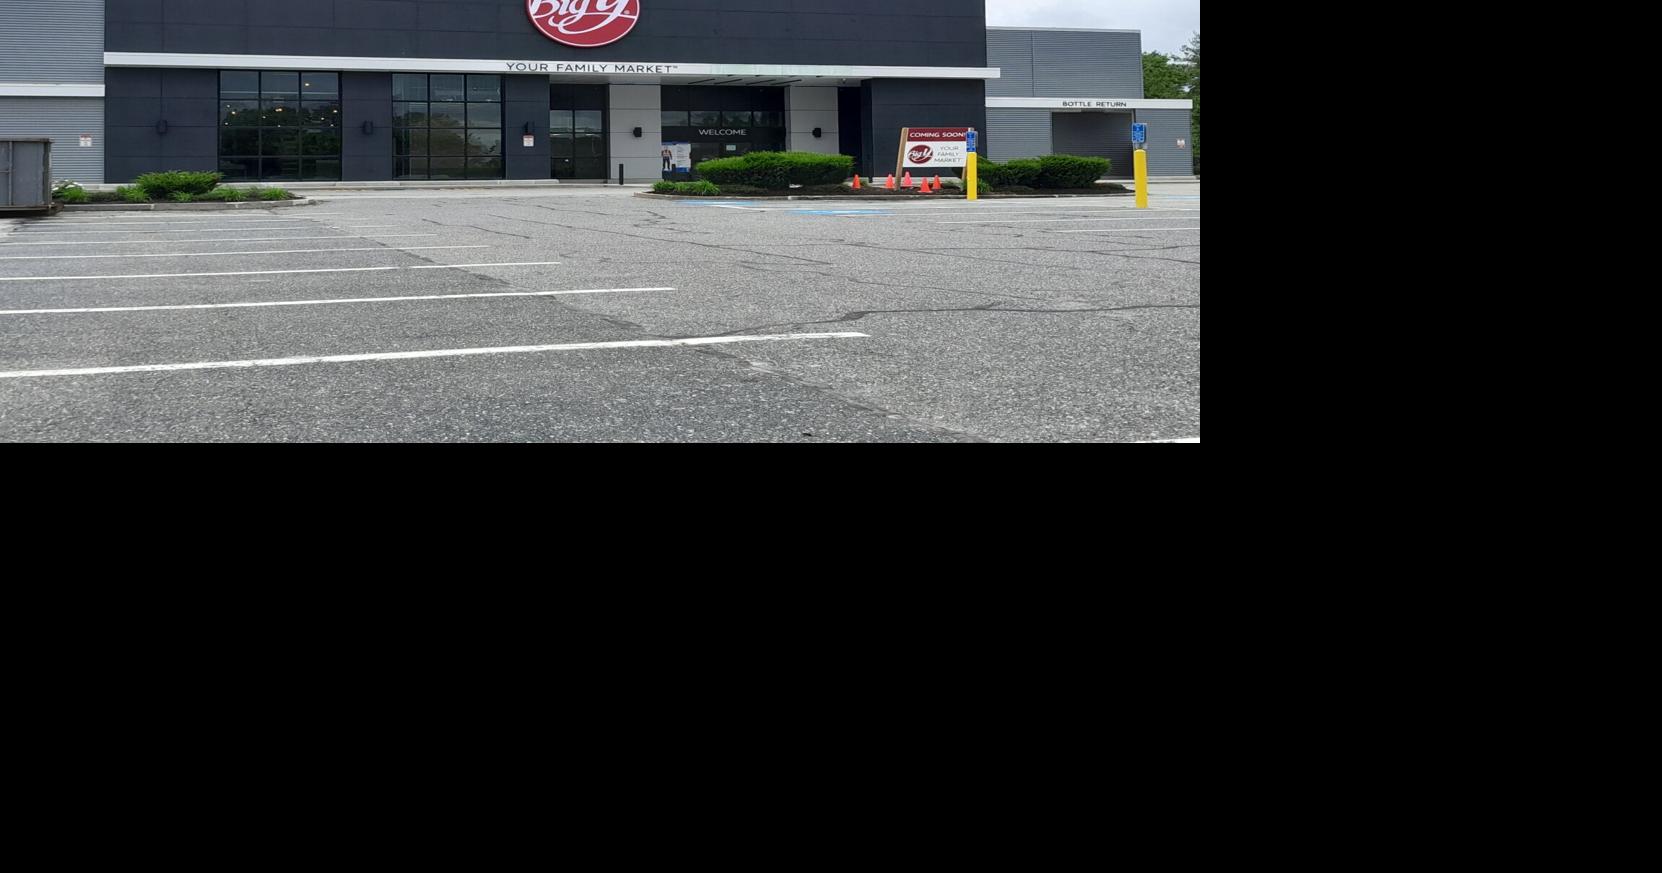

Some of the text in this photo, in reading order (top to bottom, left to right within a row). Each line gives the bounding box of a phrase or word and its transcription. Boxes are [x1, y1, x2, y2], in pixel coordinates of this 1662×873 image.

[506, 62, 549, 72] YOUR
[556, 63, 608, 73] FAMILY
[698, 128, 748, 136] WELCOME
